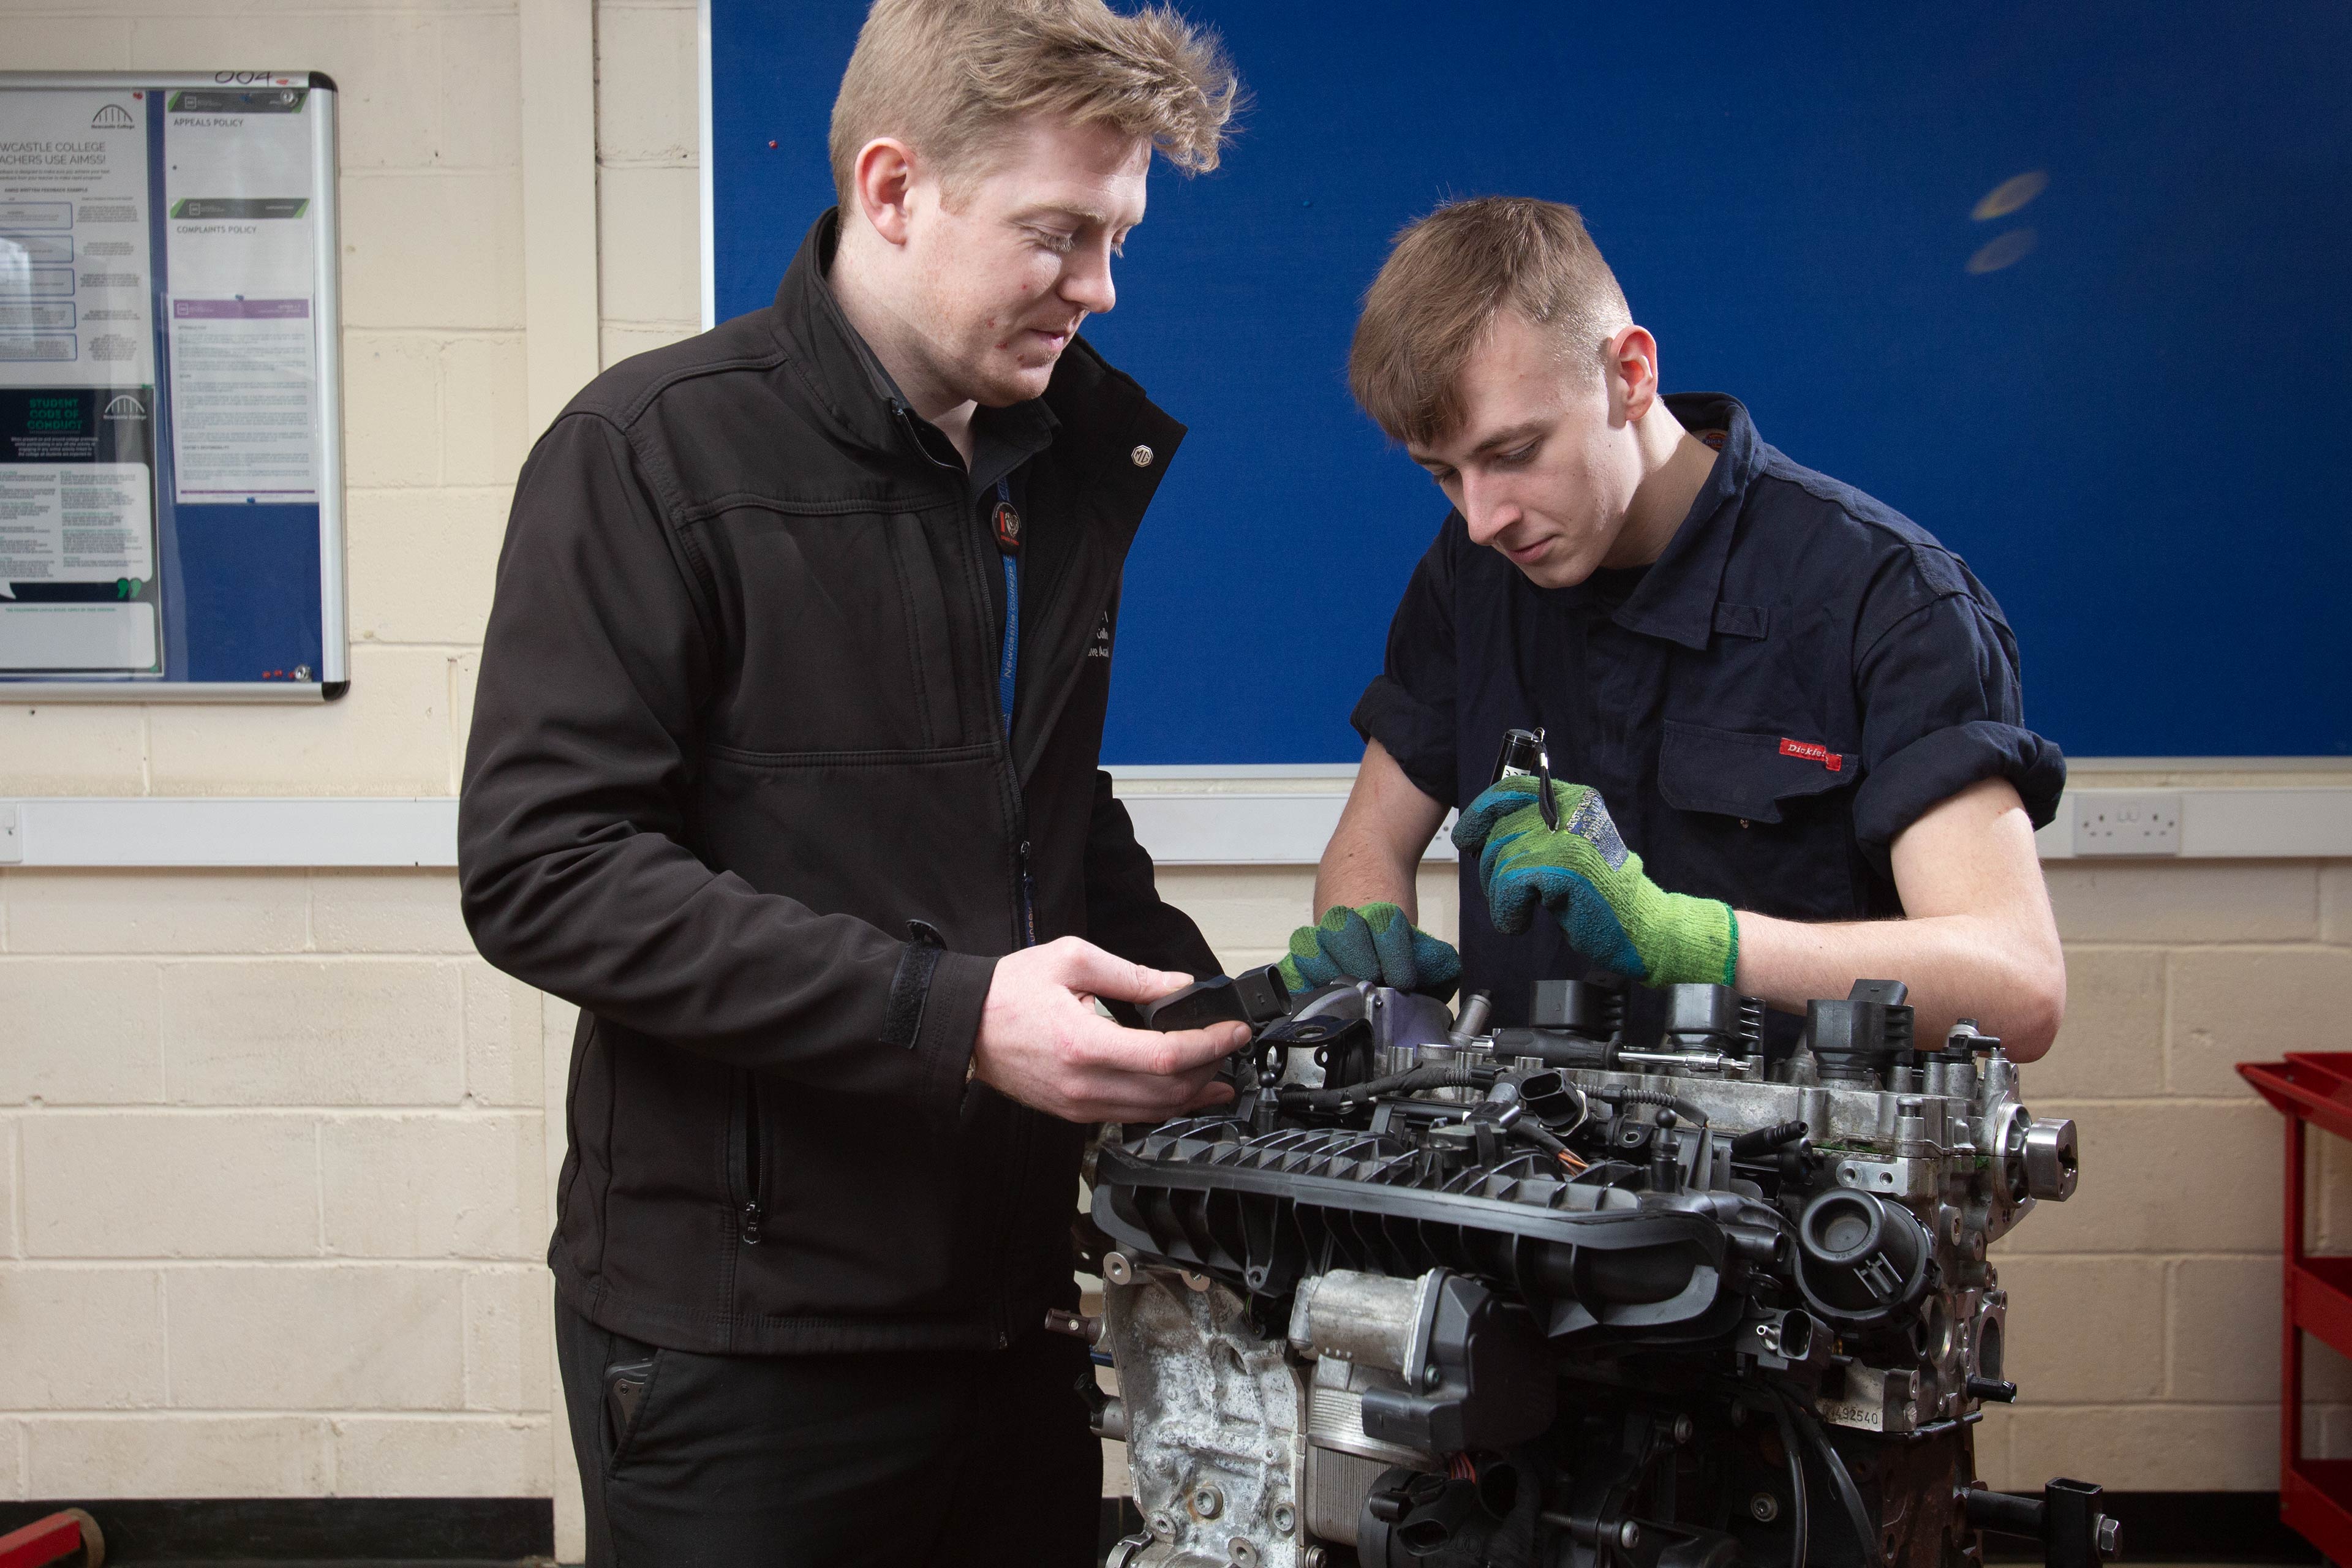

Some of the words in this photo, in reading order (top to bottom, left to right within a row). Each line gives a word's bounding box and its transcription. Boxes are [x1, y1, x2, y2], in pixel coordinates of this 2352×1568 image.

[55, 141, 106, 153] COLLEGE
[45, 154, 67, 165] USE
[29, 398, 79, 409] STUDENT
[29, 410, 61, 419] CODE
[64, 410, 79, 418] OF
[27, 420, 83, 429] CONDUCT
[1135, 450, 1150, 463] MG
[1004, 616, 1016, 678] Newcastle
